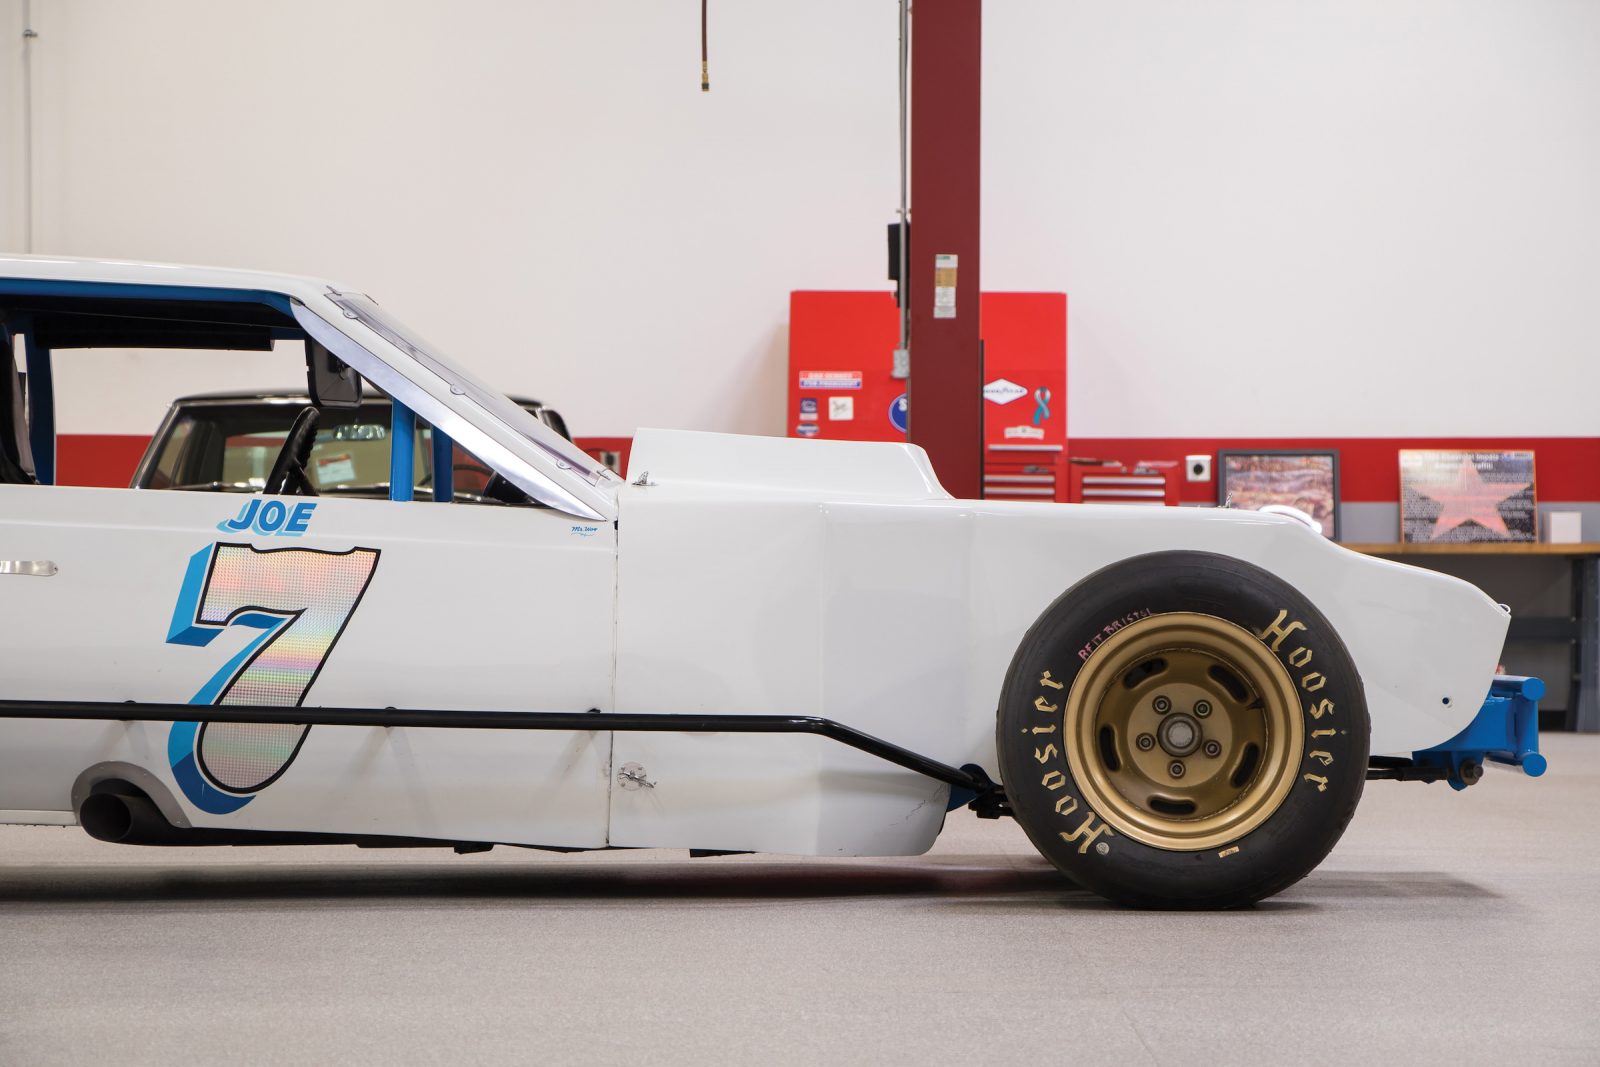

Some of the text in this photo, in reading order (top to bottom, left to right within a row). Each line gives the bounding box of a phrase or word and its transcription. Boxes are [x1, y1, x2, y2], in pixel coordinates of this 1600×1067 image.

[217, 498, 318, 536] JOE
[165, 541, 381, 815] 7
[1021, 670, 1115, 854] Hoosier
[1260, 609, 1346, 792] Hoosier
